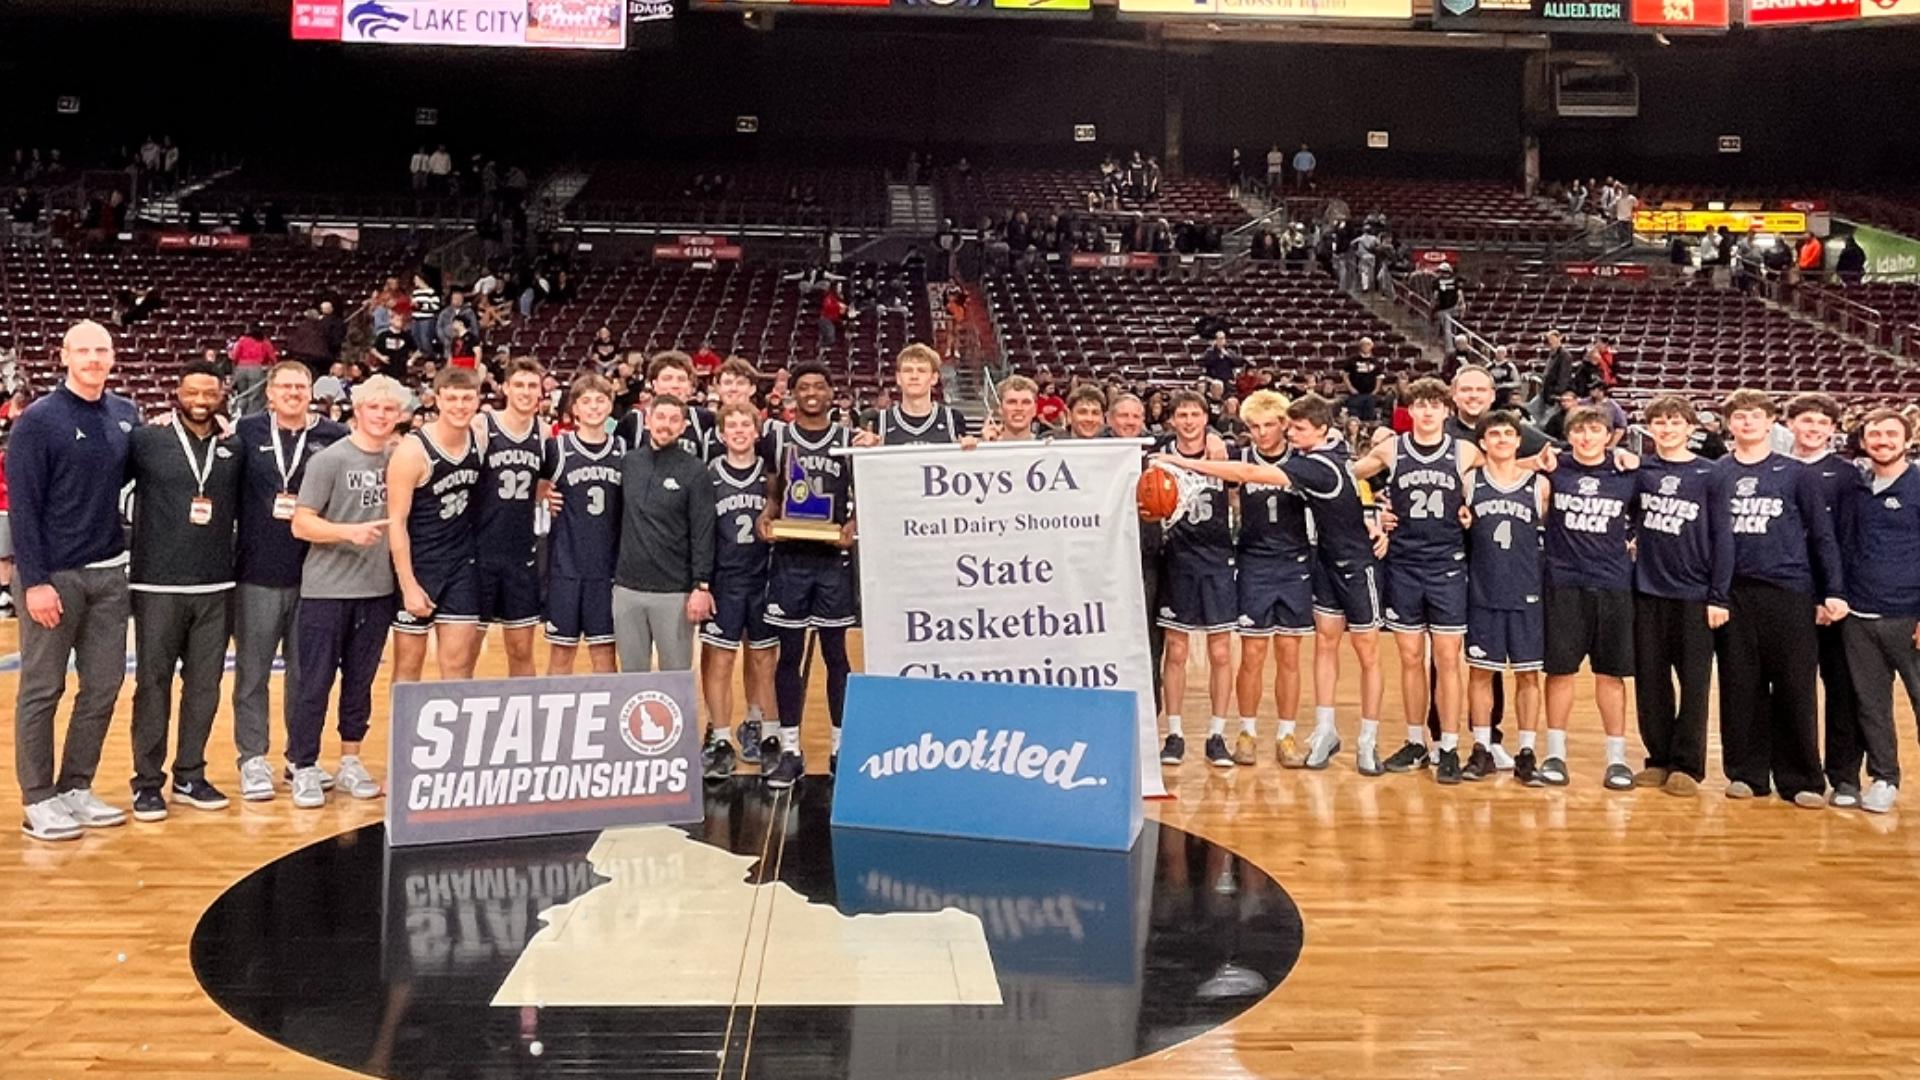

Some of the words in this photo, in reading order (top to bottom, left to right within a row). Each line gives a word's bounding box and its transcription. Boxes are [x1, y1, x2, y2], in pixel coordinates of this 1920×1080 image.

[413, 9, 467, 31] LAKE
[475, 10, 523, 32] CITY
[629, 3, 673, 14] IDAHO
[1543, 3, 1621, 18] ALLIED.TECH
[1876, 254, 1916, 273] Idaho
[347, 468, 387, 489] WOL
[800, 455, 841, 477] OLVES
[498, 470, 532, 499] 32
[922, 464, 1013, 505] Boys
[1026, 459, 1080, 492] 6A
[1398, 470, 1456, 491] WOLVES
[586, 485, 605, 516] 3
[1267, 495, 1278, 523] 1
[1409, 490, 1444, 519] 24
[1474, 499, 1532, 523] WOLVES
[1554, 492, 1624, 518] WOLVES
[1730, 497, 1784, 518] OLVES
[735, 514, 755, 544] 2
[903, 519, 948, 537] Real
[953, 516, 1009, 536] Dairy
[1015, 513, 1101, 531] Shootout
[1492, 520, 1512, 550] 4
[1564, 511, 1610, 534] BACK
[1731, 515, 1770, 534] ACK
[956, 554, 1054, 588] State
[905, 601, 1106, 642] Basketball
[411, 691, 611, 770] STATE
[408, 757, 688, 811] CHAMPIONSHIPS
